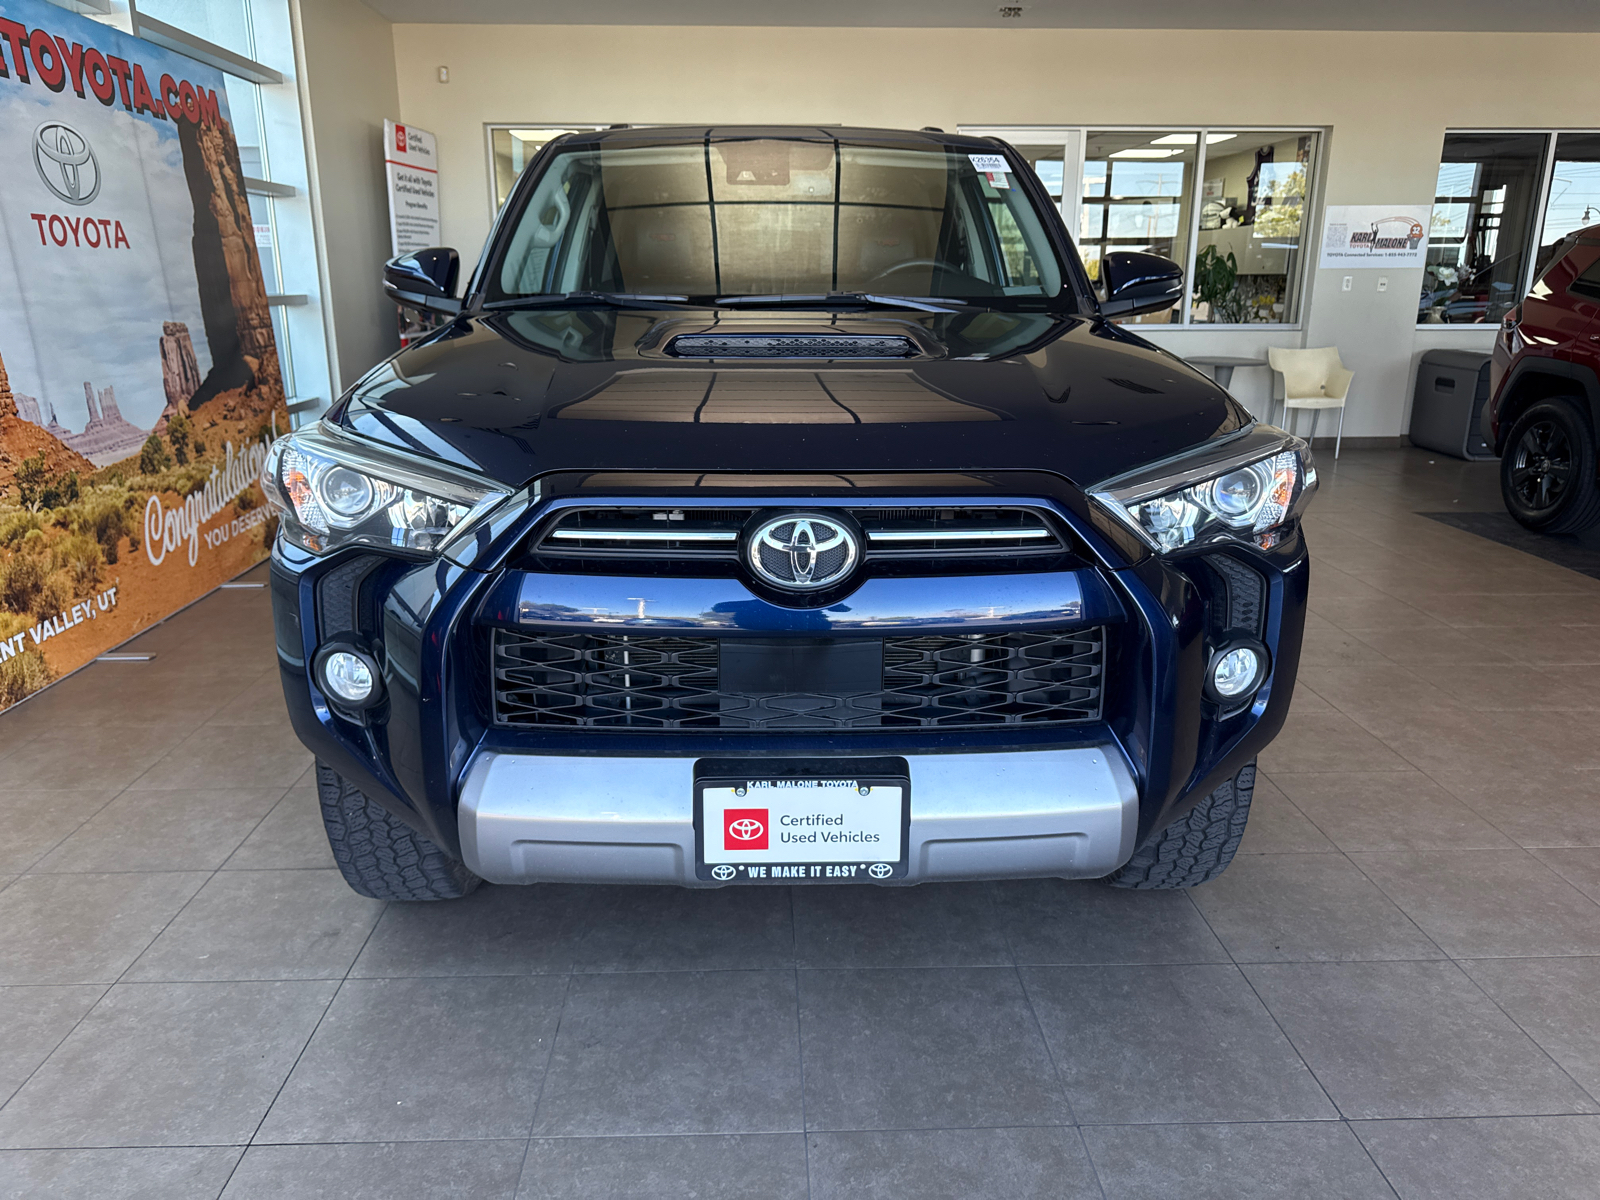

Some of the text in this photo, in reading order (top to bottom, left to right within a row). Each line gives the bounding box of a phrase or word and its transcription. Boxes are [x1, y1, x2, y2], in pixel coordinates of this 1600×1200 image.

[0, 16, 224, 131] TOYOTA.COM
[407, 132, 423, 144] Certified
[395, 183, 412, 194] Certified
[31, 213, 131, 249] TOYOTA
[1412, 226, 1421, 234] 32
[1350, 232, 1408, 248] KARL MALONE
[204, 524, 229, 549] YOU
[29, 599, 97, 645] VALLEY,
[97, 586, 117, 611] UT
[746, 780, 858, 789] KARL MALONE TOYOTA
[780, 814, 844, 826] Certified
[780, 831, 880, 843] Used Vehicles
[747, 865, 857, 878] WE MAKE IT EASY
